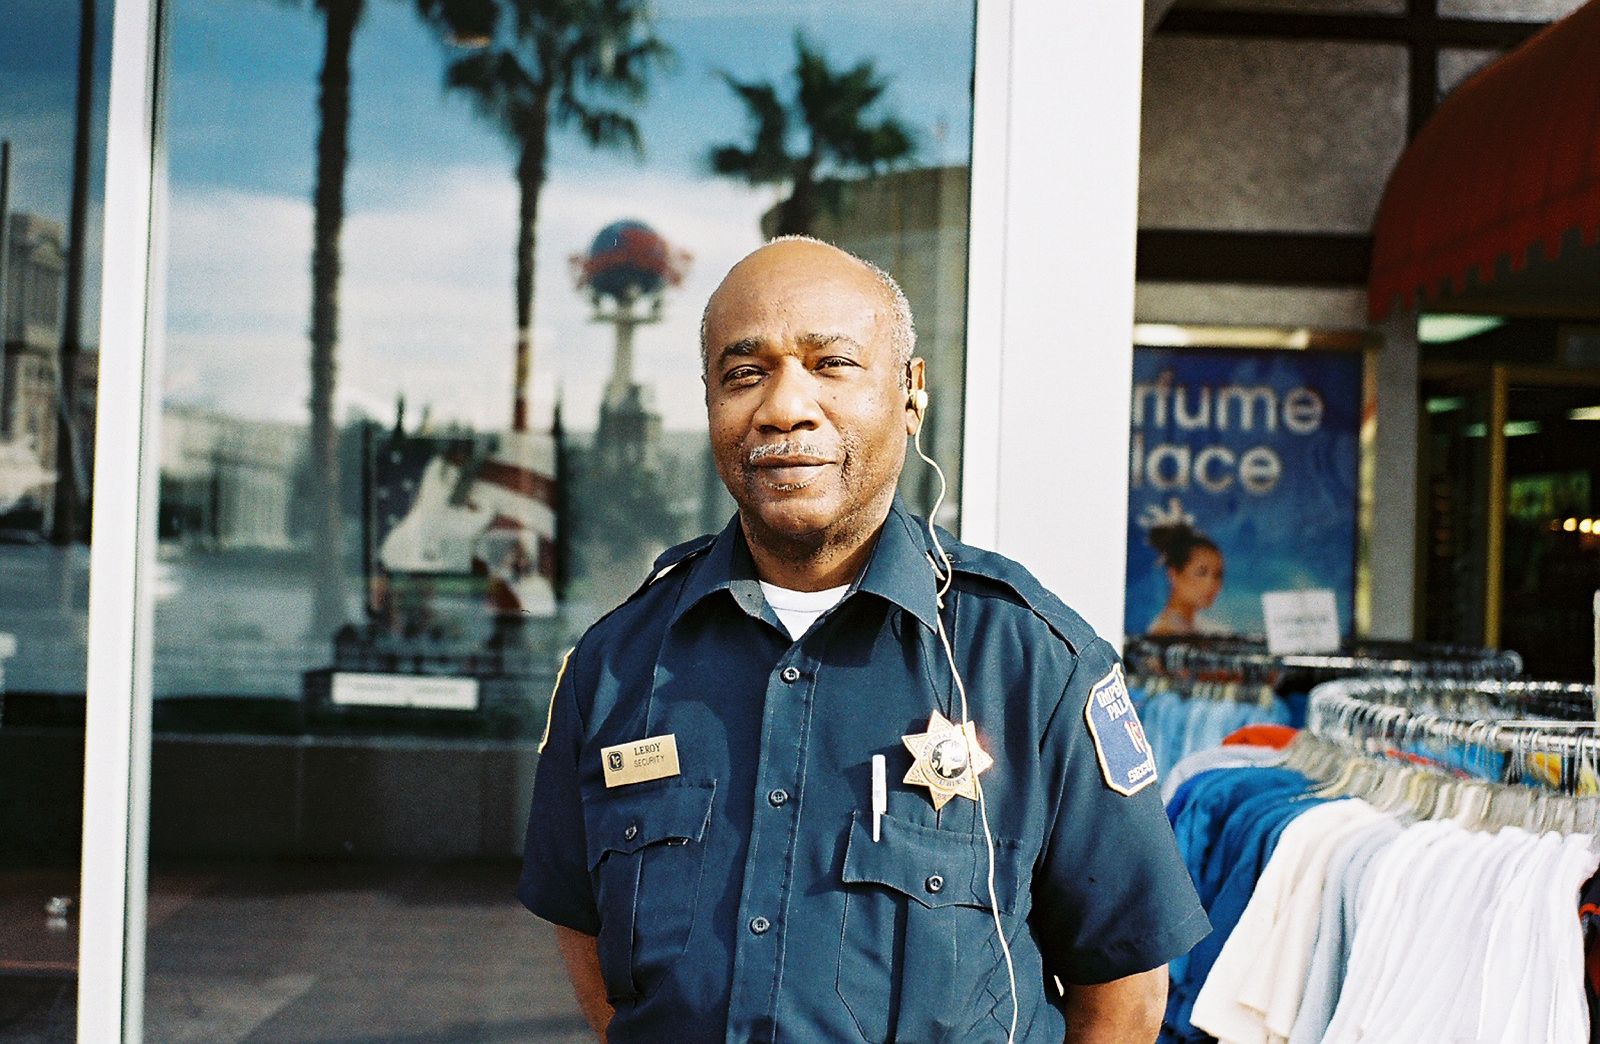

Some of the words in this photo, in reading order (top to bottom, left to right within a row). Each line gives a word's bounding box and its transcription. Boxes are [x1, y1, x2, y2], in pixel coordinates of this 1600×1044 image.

[1131, 431, 1282, 493] lace
[633, 742, 661, 756] LEROY
[632, 754, 665, 768] SECURITY
